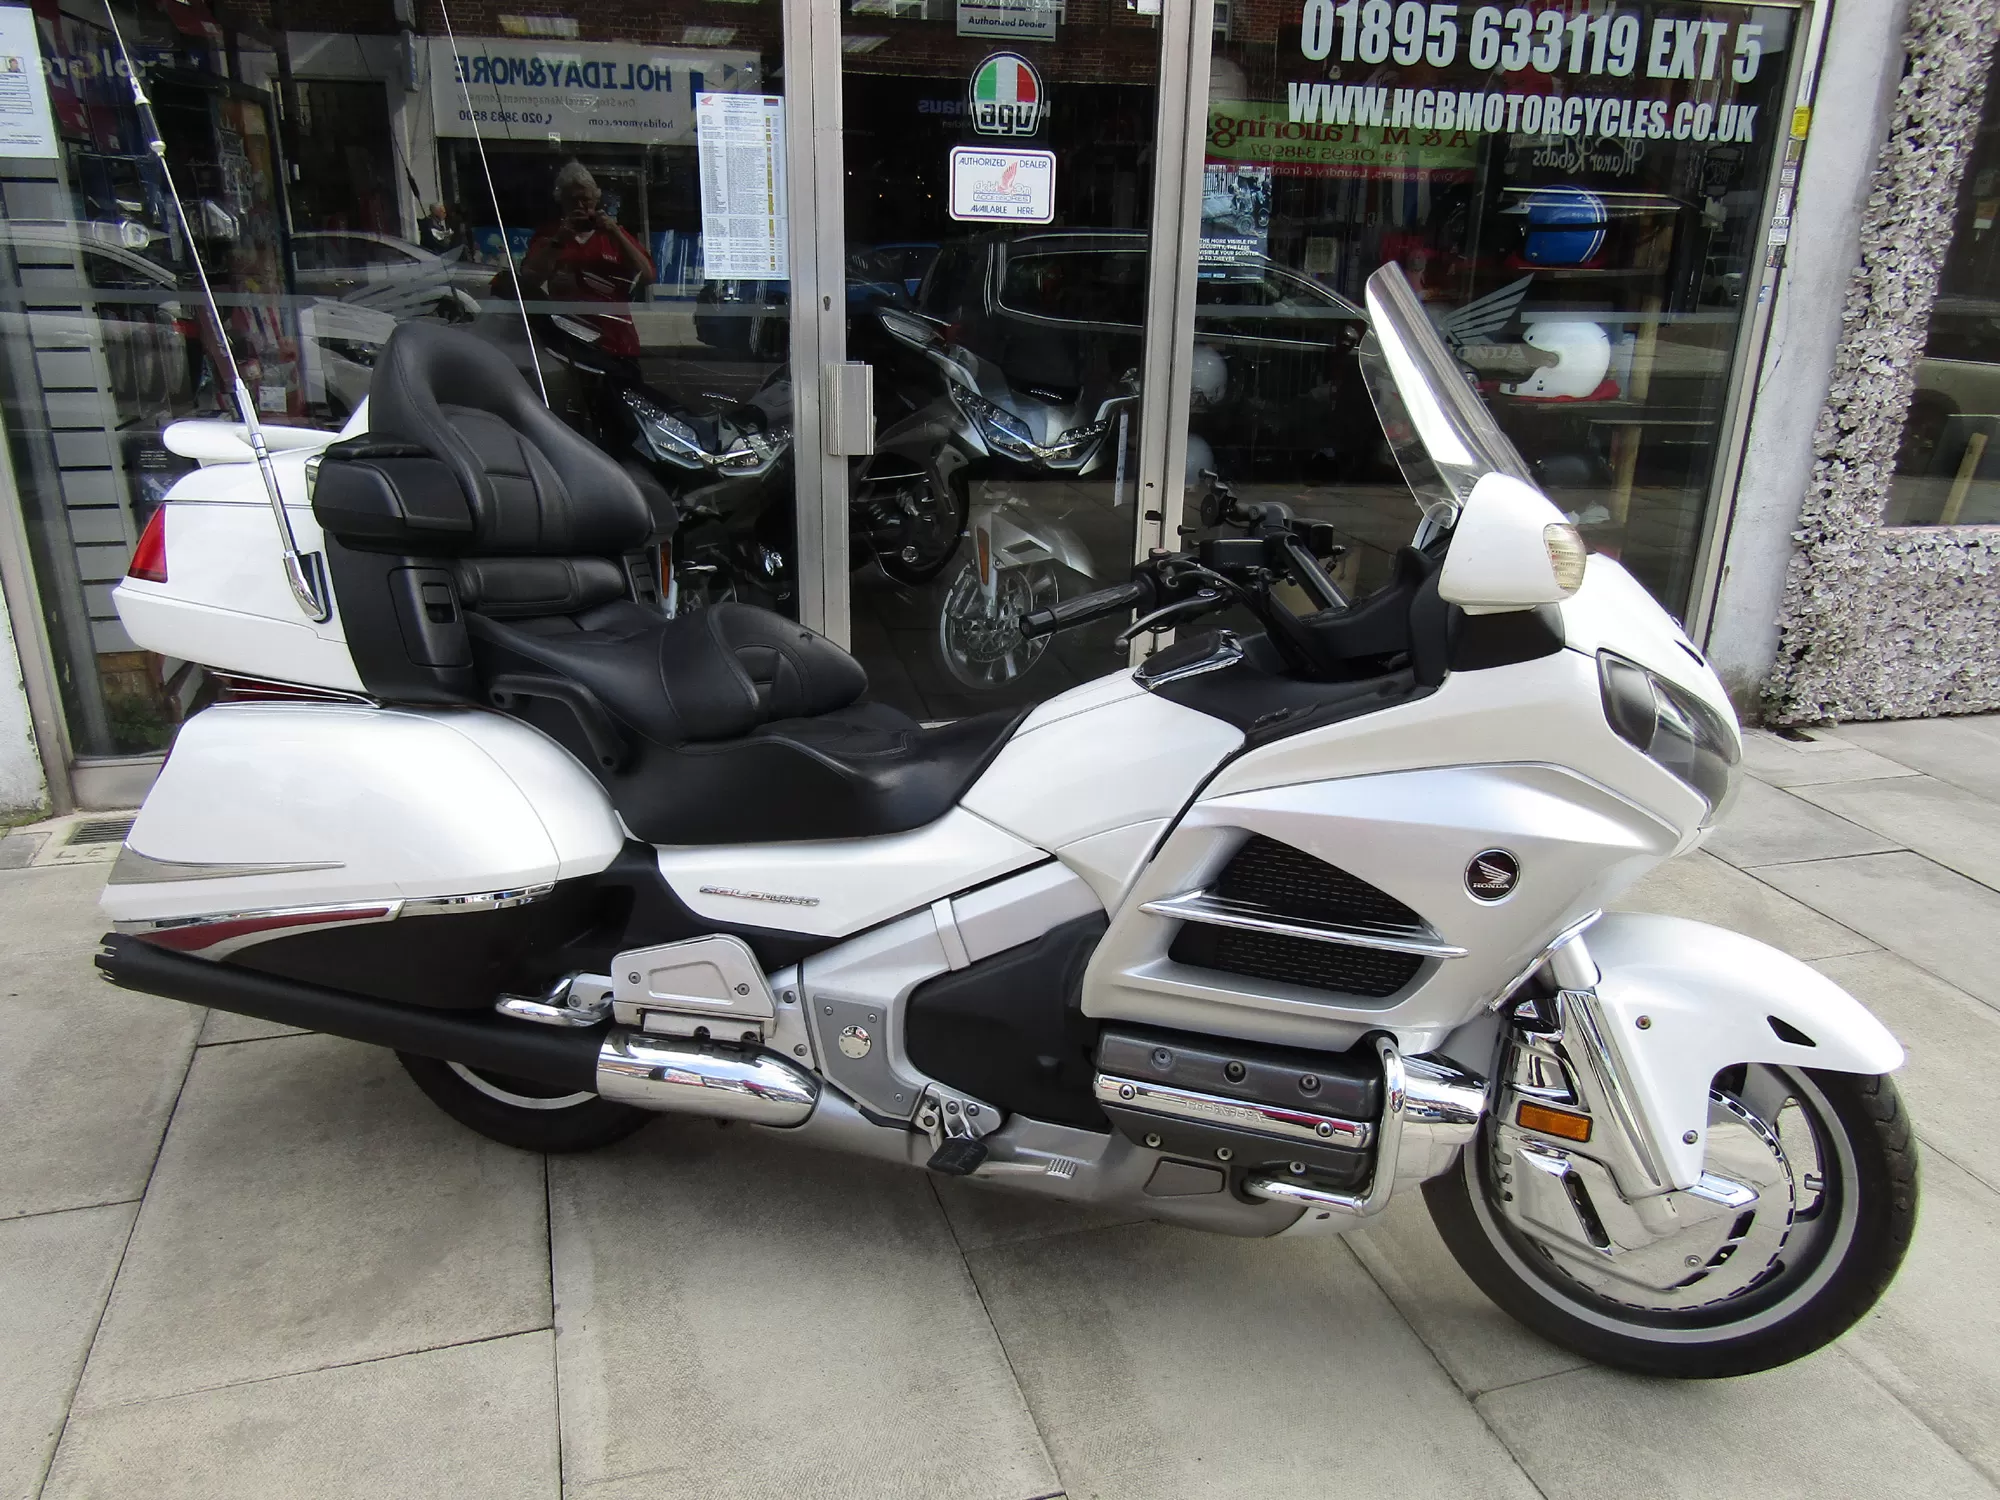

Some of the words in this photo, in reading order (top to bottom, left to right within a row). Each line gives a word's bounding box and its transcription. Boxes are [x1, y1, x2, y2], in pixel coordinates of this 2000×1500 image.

[967, 16, 1016, 27] Authorized
[1018, 18, 1046, 29] Dealer
[1300, 0, 1460, 69] 01895
[1469, 6, 1640, 77] 633119
[1646, 18, 1728, 82] EXT
[1732, 24, 1764, 83] 5
[980, 103, 1034, 134] agv
[1288, 82, 1759, 143] WWW.HGBMOTORCYCLES.CO.UK
[959, 157, 1006, 167] AUTHORIZED
[1019, 159, 1048, 169] DEALER
[970, 204, 1008, 214] AVAILABLE
[1016, 206, 1035, 215] HERE
